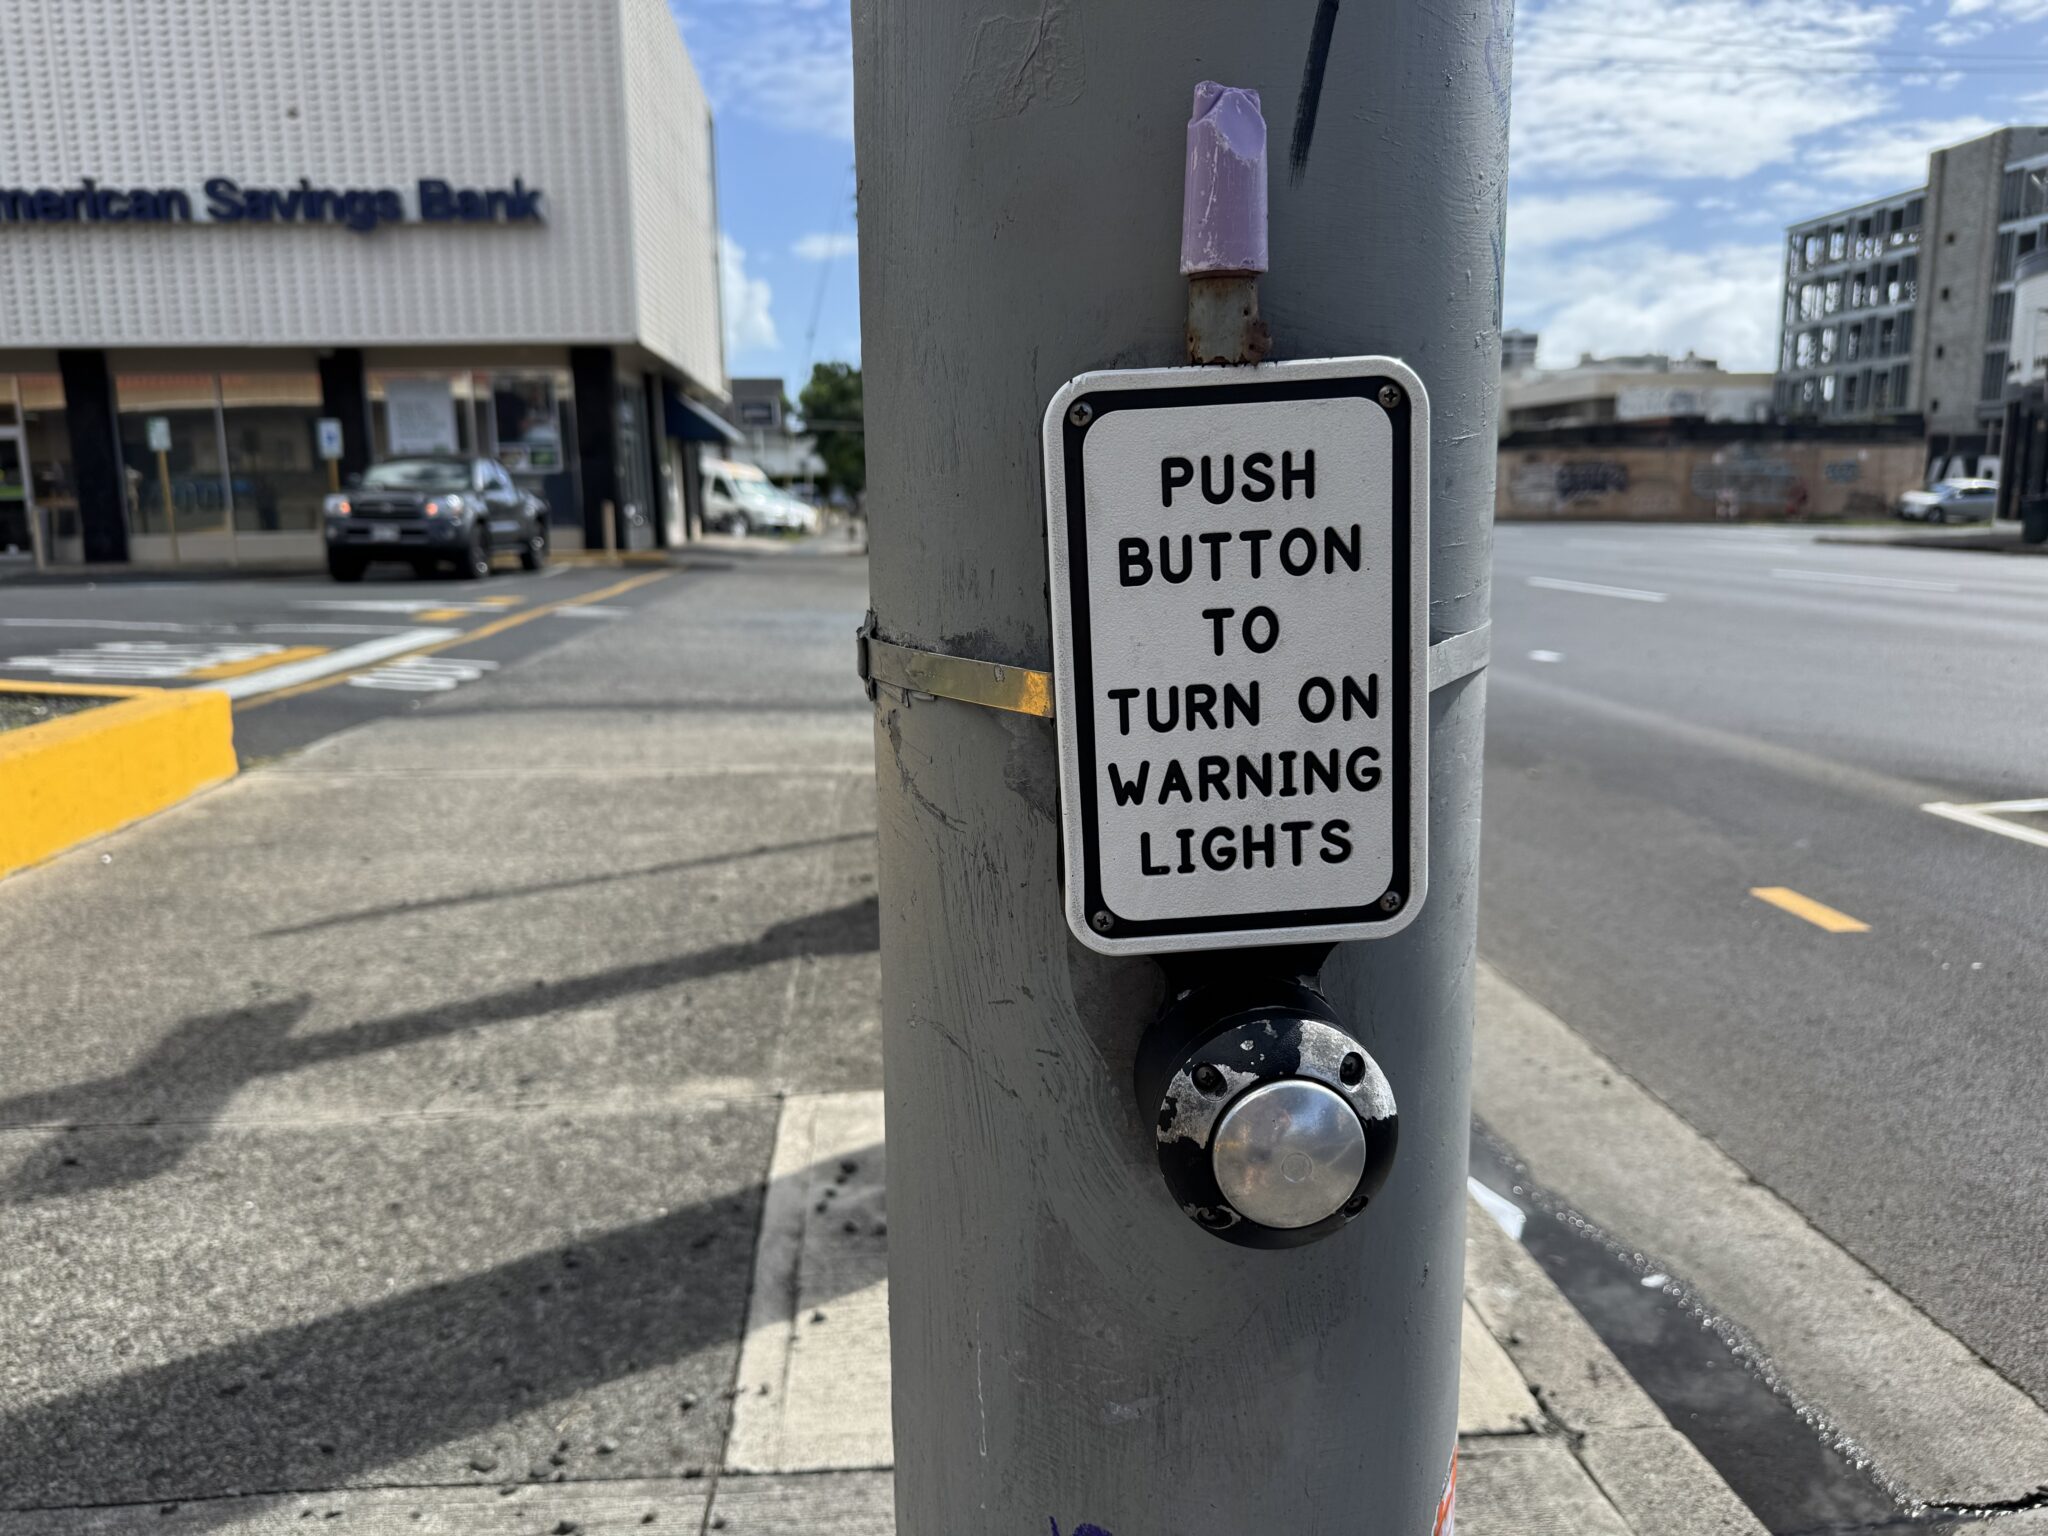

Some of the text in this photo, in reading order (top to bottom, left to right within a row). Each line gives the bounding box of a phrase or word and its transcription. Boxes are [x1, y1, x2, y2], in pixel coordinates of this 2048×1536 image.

[203, 178, 404, 232] Savings
[418, 174, 546, 223] Bank
[1160, 448, 1316, 508] PUSH
[1118, 523, 1362, 588] BUTTON
[1201, 605, 1281, 657] TO
[1107, 672, 1380, 737] TURN ON
[1107, 745, 1383, 807] WARNING
[1140, 818, 1354, 877] LIGHTS
